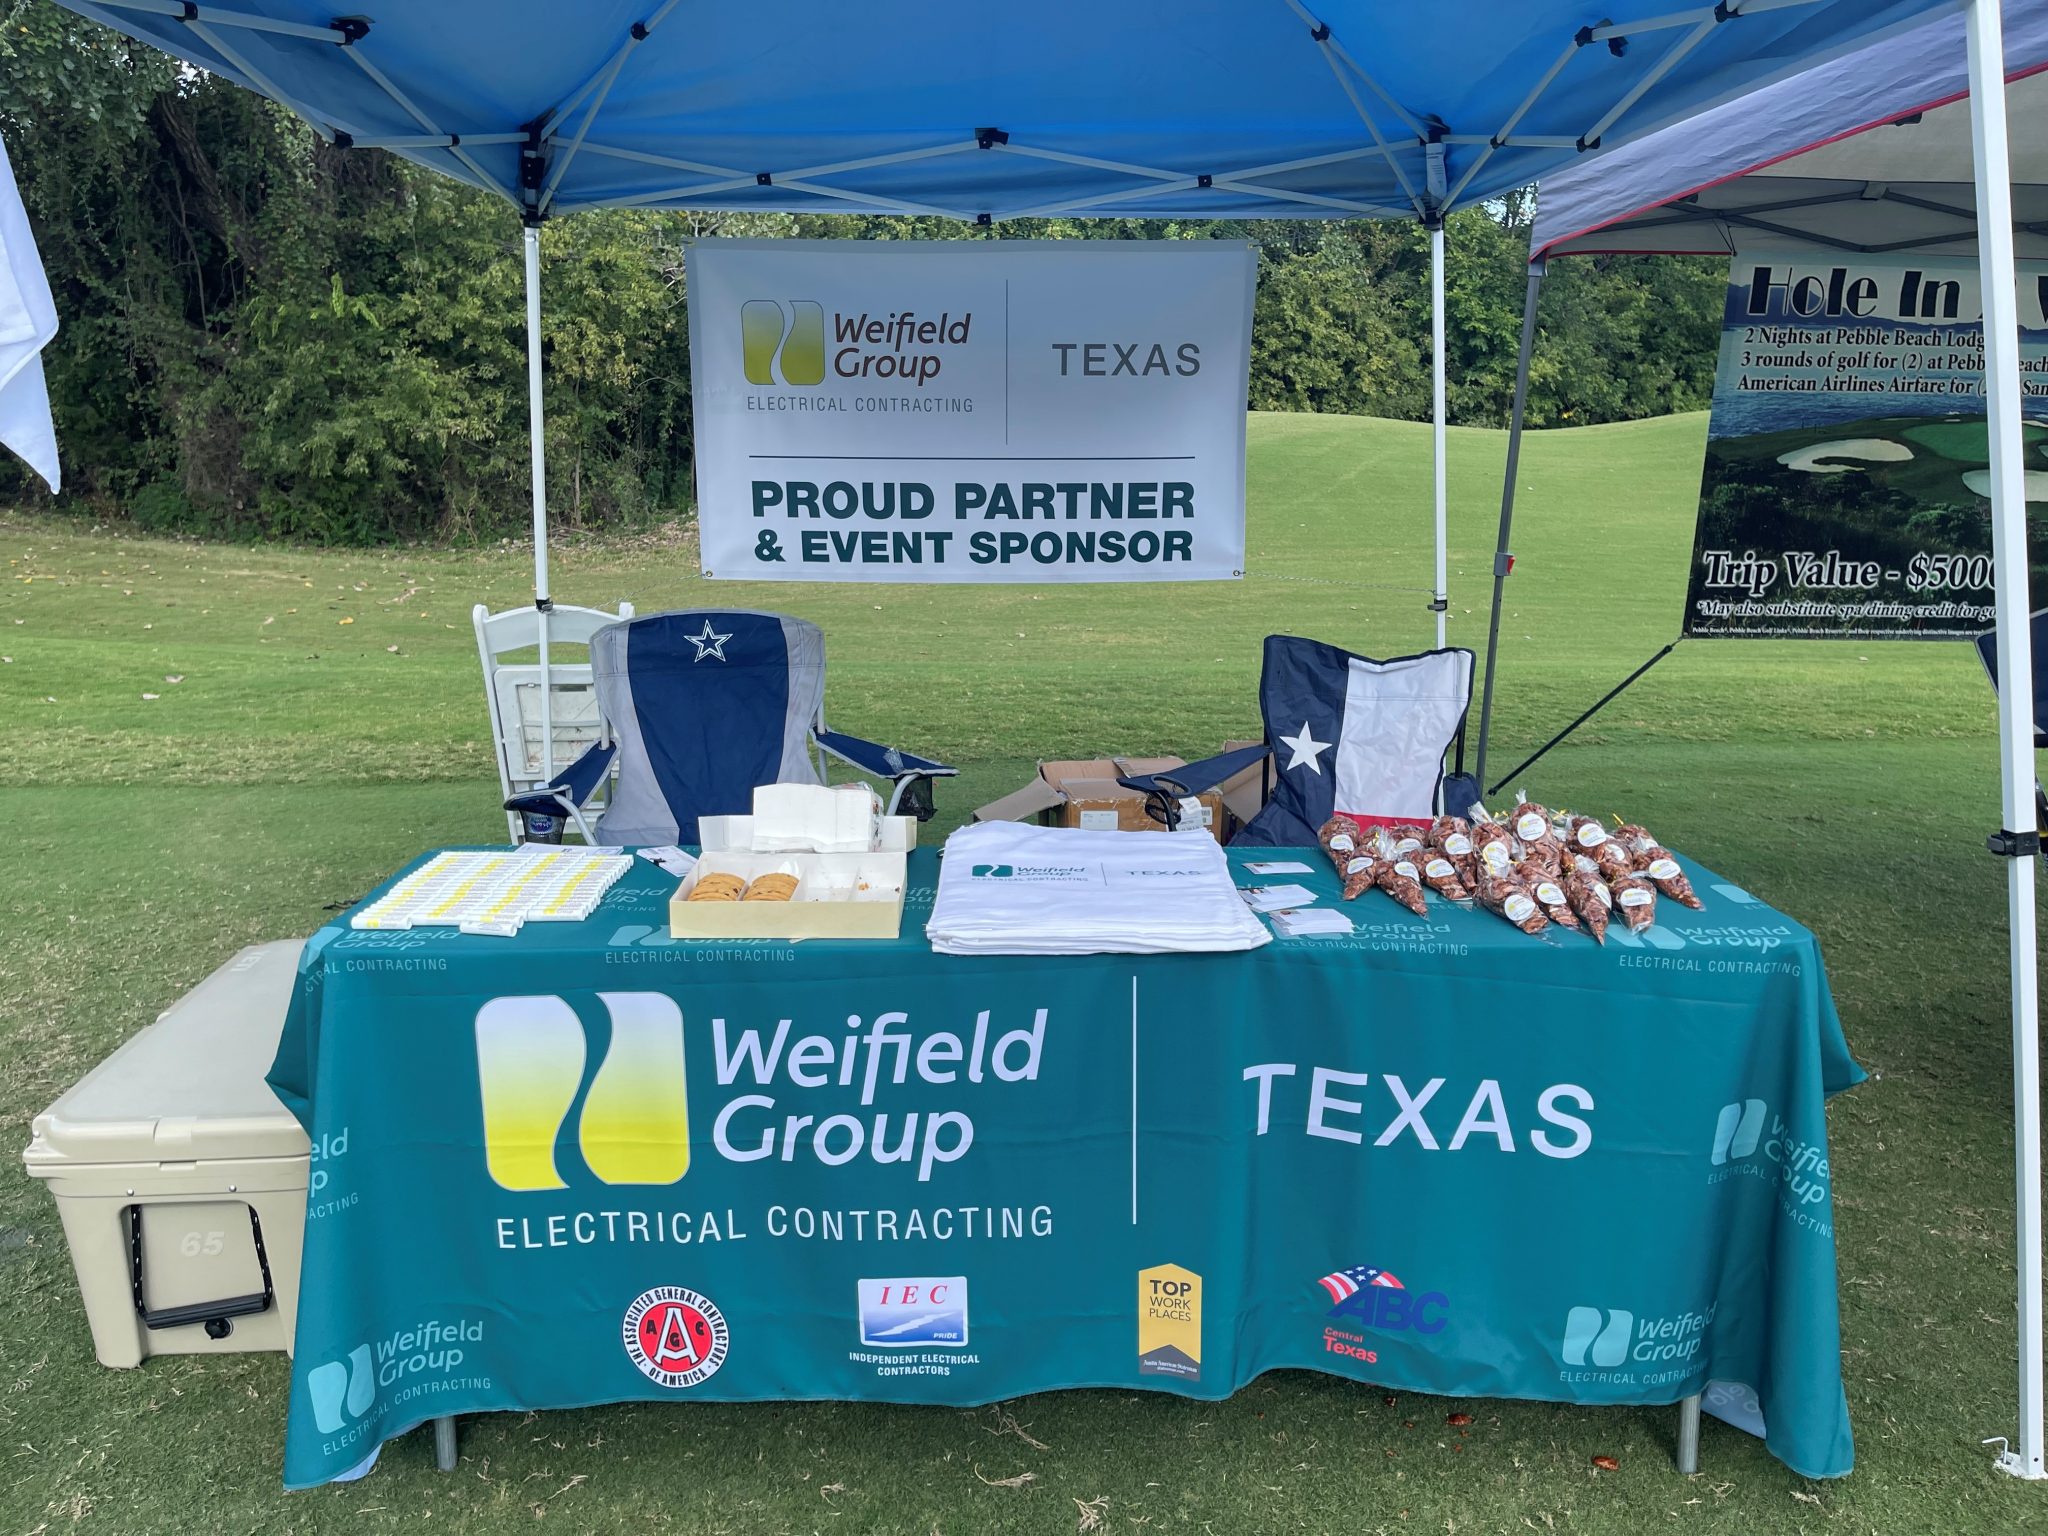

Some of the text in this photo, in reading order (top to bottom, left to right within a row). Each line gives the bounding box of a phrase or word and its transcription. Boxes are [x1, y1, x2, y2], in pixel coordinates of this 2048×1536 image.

[1748, 266, 1878, 317] Hole
[1899, 270, 1960, 318] In
[834, 312, 972, 352] Weifield
[1744, 327, 1984, 352] 2 Nights at Pebble Beach Lodg
[834, 347, 941, 386] Group
[1052, 343, 1201, 377] TEXAS
[1741, 351, 1751, 367] 3
[1755, 351, 1813, 367] rounds
[1817, 351, 1836, 368] of
[1837, 351, 1872, 372] golf
[1873, 352, 1898, 369] for
[1902, 352, 1923, 371] (2)
[1927, 355, 1944, 370] at
[1947, 354, 1985, 371] Pebb
[1737, 374, 1817, 391] American
[1821, 375, 1885, 392] Airlines
[1888, 376, 1946, 393] Airfare
[1950, 377, 1973, 394] for
[747, 396, 974, 413] ELECTRICAL CONTRACTING
[751, 480, 1195, 520] PROUD PARTNER
[754, 529, 1193, 564] & EVENT SPONSOR
[1703, 551, 1777, 597] Trip
[1782, 550, 1880, 588] Value
[1735, 601, 1764, 616] also
[1765, 601, 1836, 617] substitute
[1837, 601, 1913, 622] spa/dining
[1914, 602, 1957, 618] credit
[1957, 602, 1980, 618] for
[1018, 866, 1085, 875] Weifield
[603, 888, 668, 898] field
[345, 930, 461, 944] Weifield
[1675, 926, 1792, 937] Weifield
[332, 938, 426, 951] Group
[1282, 940, 1469, 956] ELECTRICAL CONTRACTING
[1688, 934, 1782, 954] Group
[346, 958, 448, 972] CONTRACTING
[605, 949, 795, 964] ELECTRICAL CONTRACTING
[1619, 954, 1801, 977] ELECTRICAL CONTRACTING
[712, 1008, 1049, 1105] Weifield
[1242, 1063, 1595, 1160] TEXAS
[712, 1094, 974, 1181] Group
[497, 1205, 1054, 1249] ELECTRICAL CONTRACTING
[180, 1230, 226, 1258] 65
[1149, 1279, 1192, 1297] TOP
[1149, 1296, 1191, 1311] WORK
[1149, 1307, 1191, 1322] PLACES
[1325, 1284, 1450, 1335] ABC
[624, 1287, 728, 1367] THE ASSOCIATED GENERAL CONTRACTORS
[1638, 1300, 1719, 1342] Weifield
[376, 1319, 484, 1363] Weifield
[1324, 1327, 1363, 1344] Central
[849, 1352, 980, 1365] INDEPENDENT ELECTRICAL
[1323, 1335, 1378, 1364] Texas
[1633, 1338, 1702, 1362] Group
[379, 1347, 464, 1388] Group
[648, 1367, 708, 1386] OF AMERICA
[877, 1365, 950, 1377] CONTRACTORS
[1559, 1370, 1636, 1384] ELECTRICAL
[322, 1376, 492, 1456] ELECTRICAL CONTRACTING
